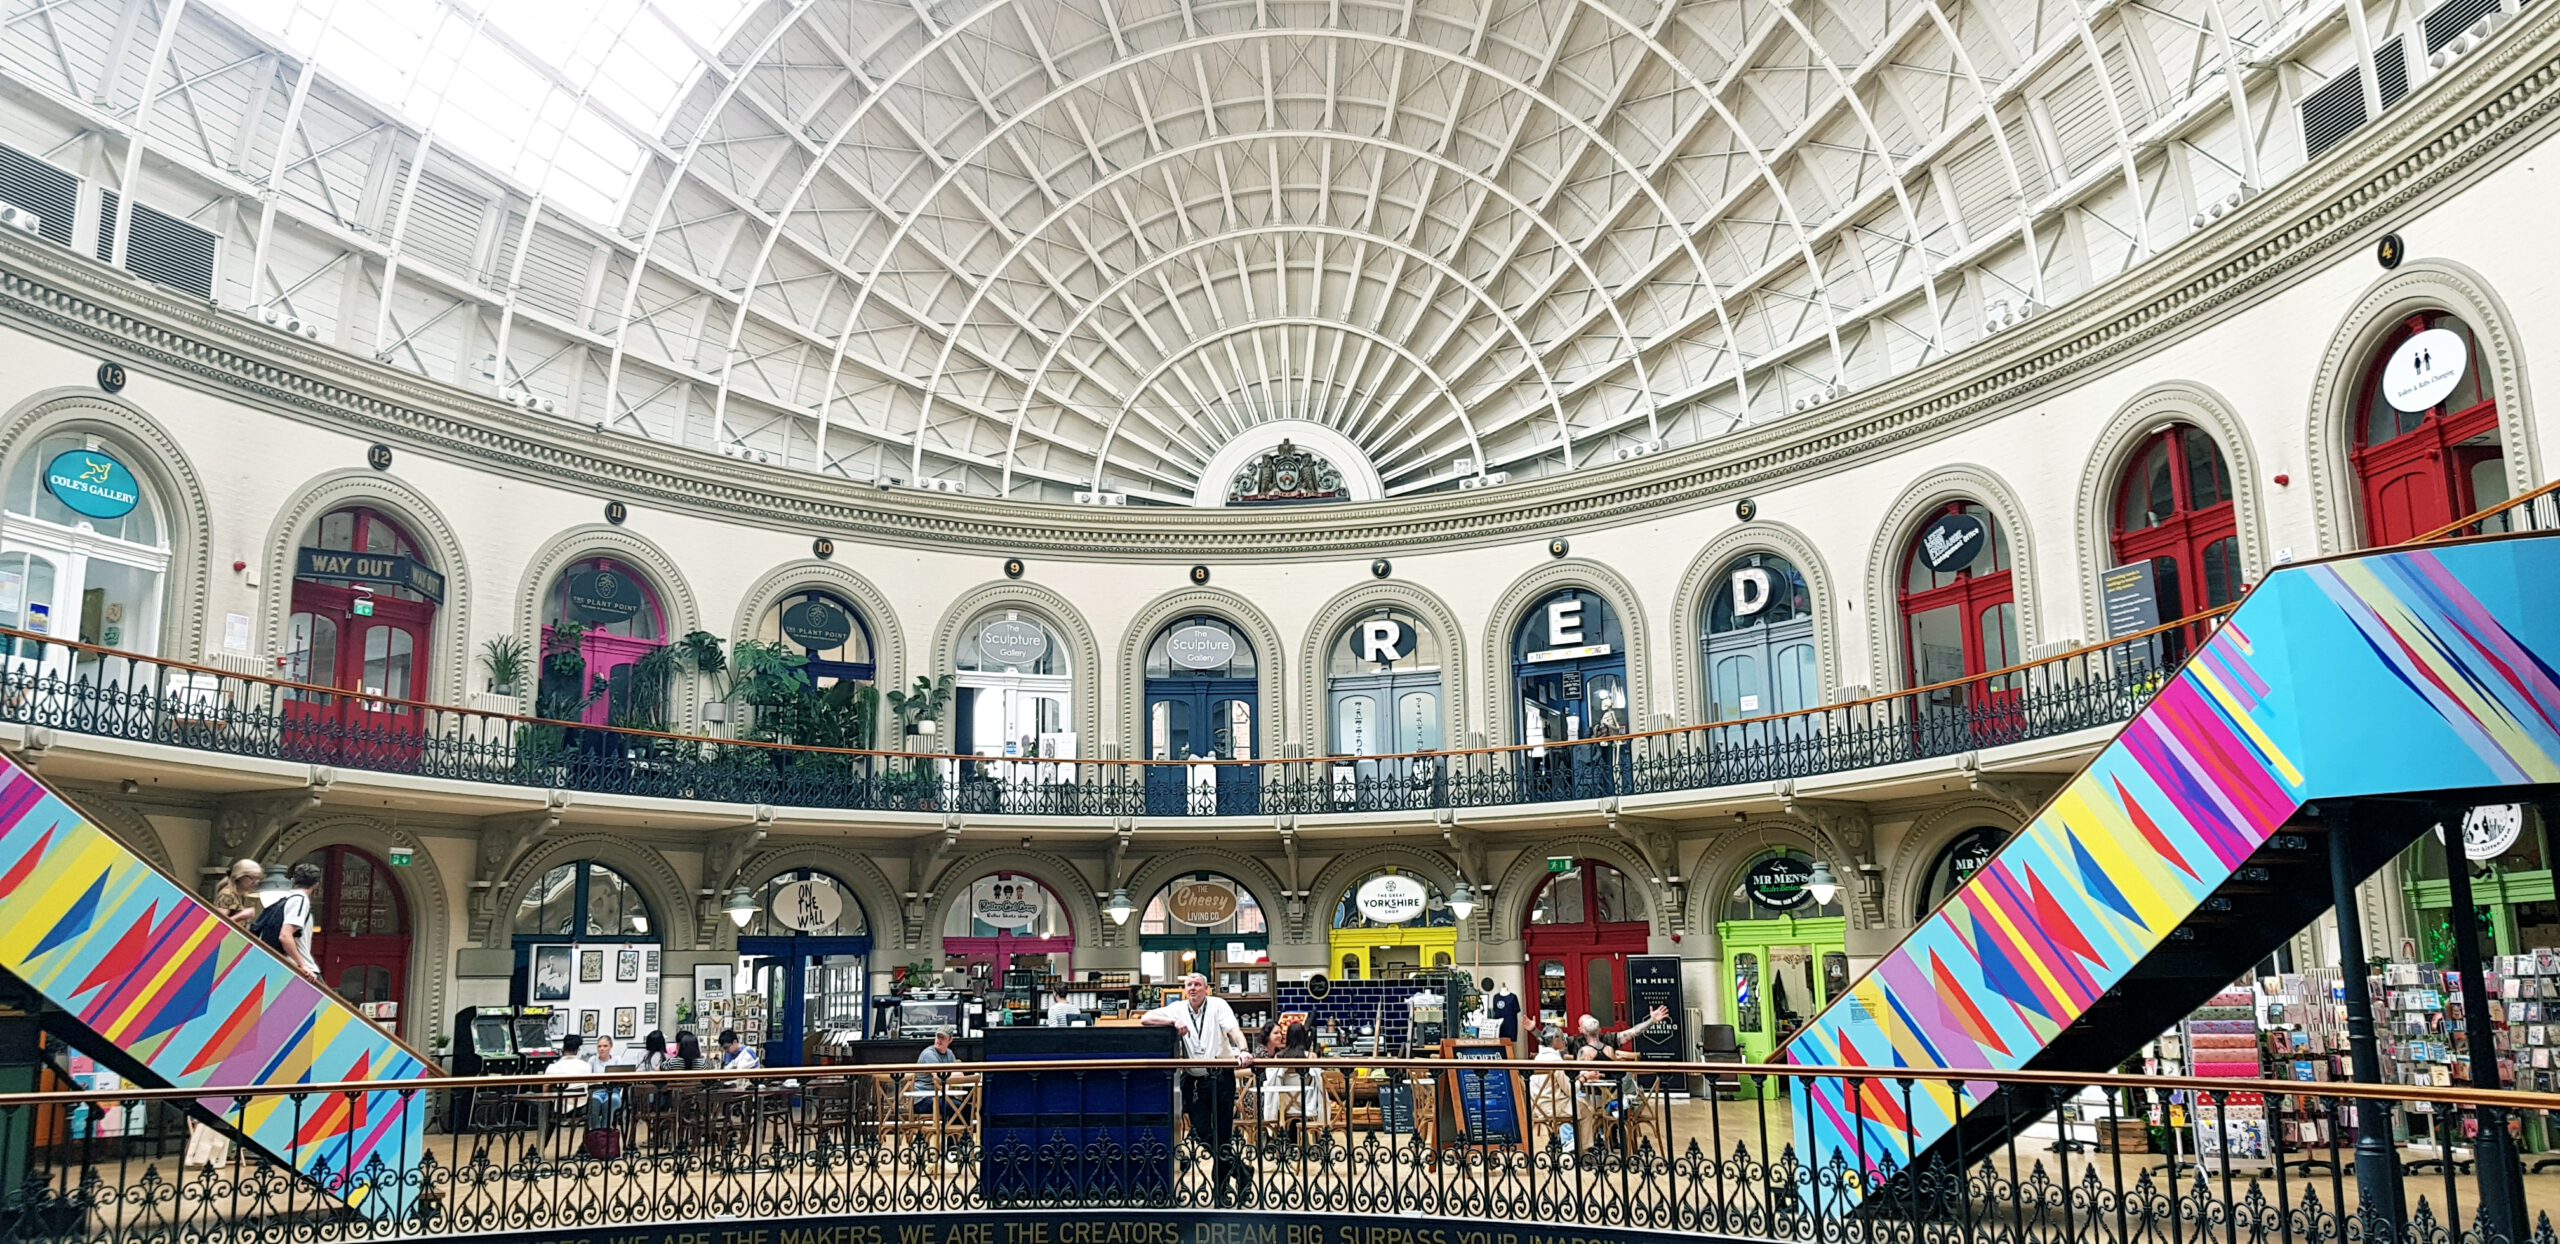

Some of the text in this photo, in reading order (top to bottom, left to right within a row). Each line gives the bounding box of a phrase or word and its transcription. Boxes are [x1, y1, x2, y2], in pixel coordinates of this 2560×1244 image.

[2382, 241, 2393, 259] 4
[105, 366, 123, 386] 13
[373, 448, 390, 464] 12
[51, 474, 136, 504] COLE'S GALLERY
[612, 505, 622, 518] 11
[1741, 504, 1749, 515] 5
[818, 541, 832, 554] 10
[1553, 541, 1562, 553] 6
[312, 555, 395, 577] WAY OUT
[1010, 563, 1020, 573] 9
[1377, 563, 1386, 574] 7
[1196, 569, 1205, 579] 8
[412, 569, 440, 596] WAY OUT
[1732, 568, 1770, 617] D
[587, 599, 611, 608] PLANT
[614, 603, 637, 612] POINT
[1006, 624, 1020, 632] The
[1548, 600, 1583, 645] E
[825, 631, 847, 639] POINT
[985, 633, 1041, 648] Sculpture
[1363, 621, 1401, 662] R
[1173, 640, 1230, 652] Sculpture
[1000, 649, 1027, 658] Gallery
[1187, 654, 1215, 663] Gallery
[1955, 858, 1974, 870] MR
[1753, 875, 1771, 885] MR
[799, 883, 812, 898] ON
[1197, 885, 1208, 893] THE
[1177, 887, 1228, 910] Cheesy
[1363, 899, 1420, 909] YORKSHIRE
[798, 897, 818, 914] THE
[797, 910, 825, 928] WALL
[1187, 912, 1208, 921] LIVING
[781, 1226, 884, 1244] MAKERS.
[899, 1224, 936, 1244] WE
[949, 1223, 994, 1244] ARE
[1003, 1223, 1049, 1244] THE
[1059, 1222, 1184, 1244] CREATORS.
[1196, 1223, 1277, 1244] DREAM
[1340, 1226, 1446, 1244] SURPASS
